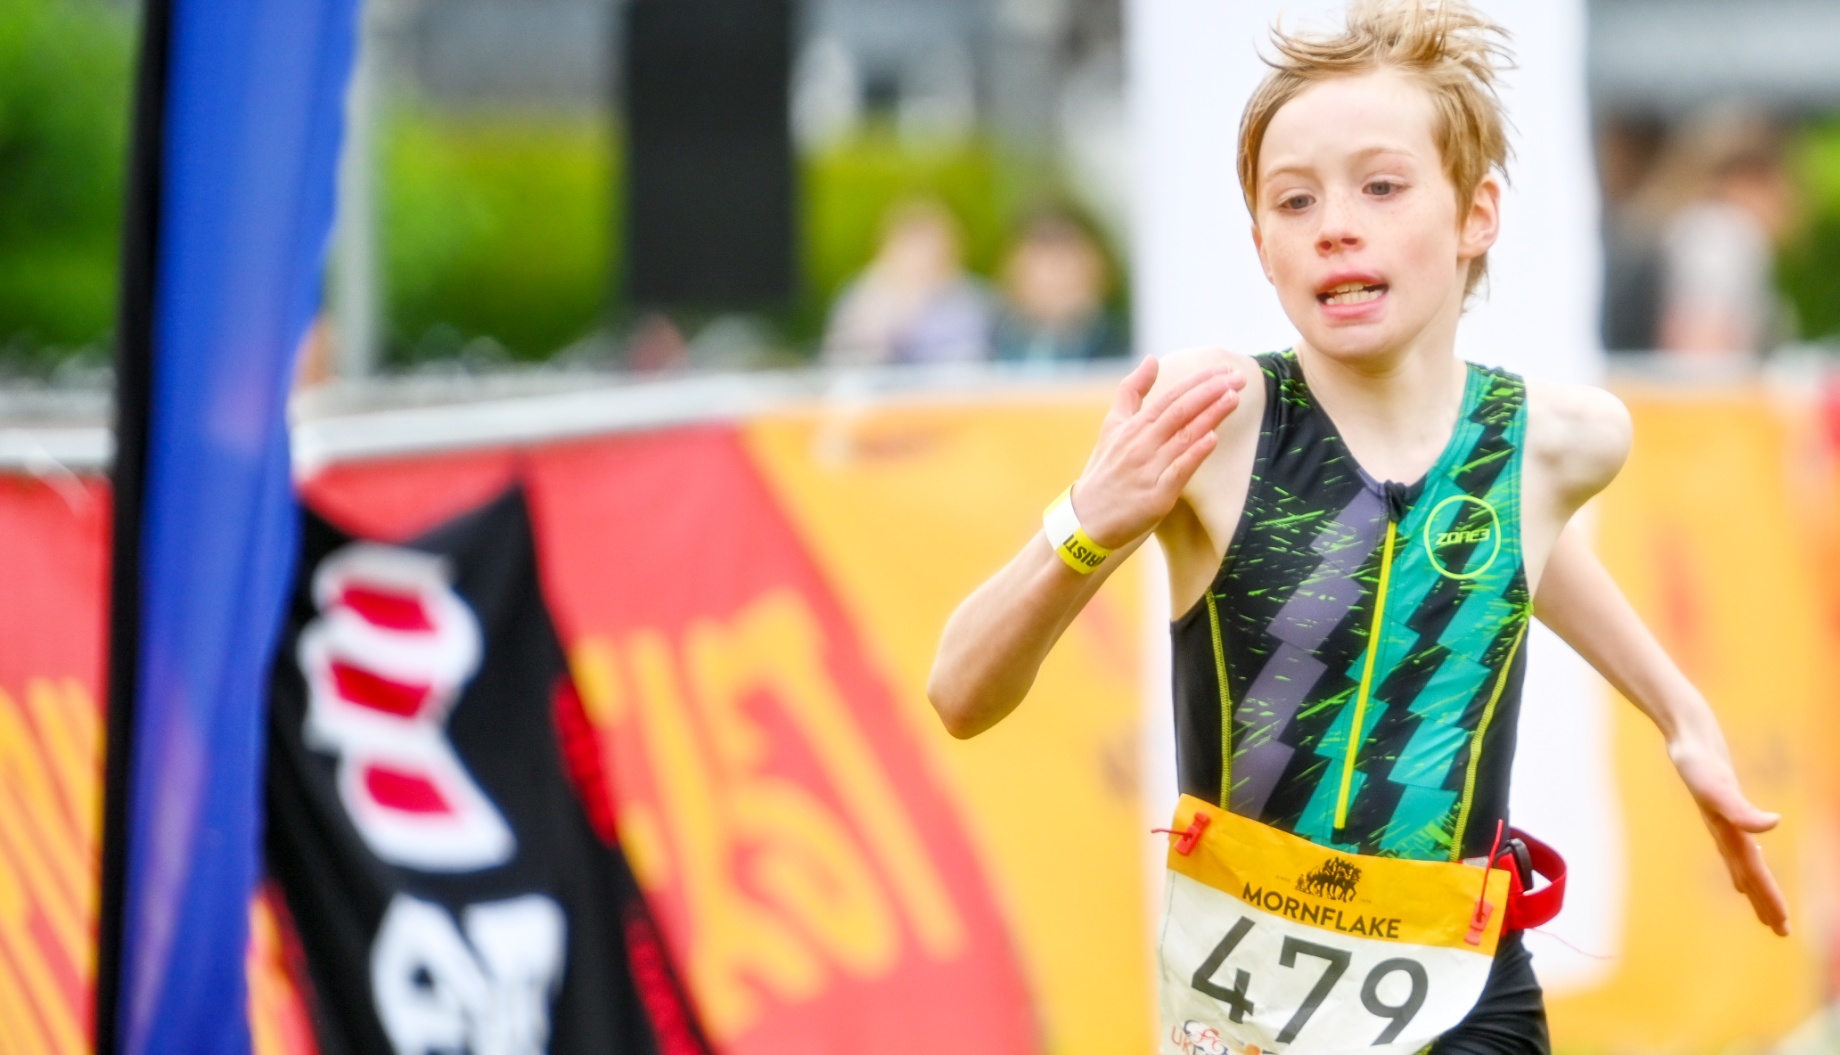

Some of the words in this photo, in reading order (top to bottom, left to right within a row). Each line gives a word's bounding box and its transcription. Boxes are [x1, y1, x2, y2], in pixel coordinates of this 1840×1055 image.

[1436, 528, 1491, 546] ZONE3
[1242, 881, 1402, 939] MORNFLAKE
[1191, 915, 1429, 1046] 479
